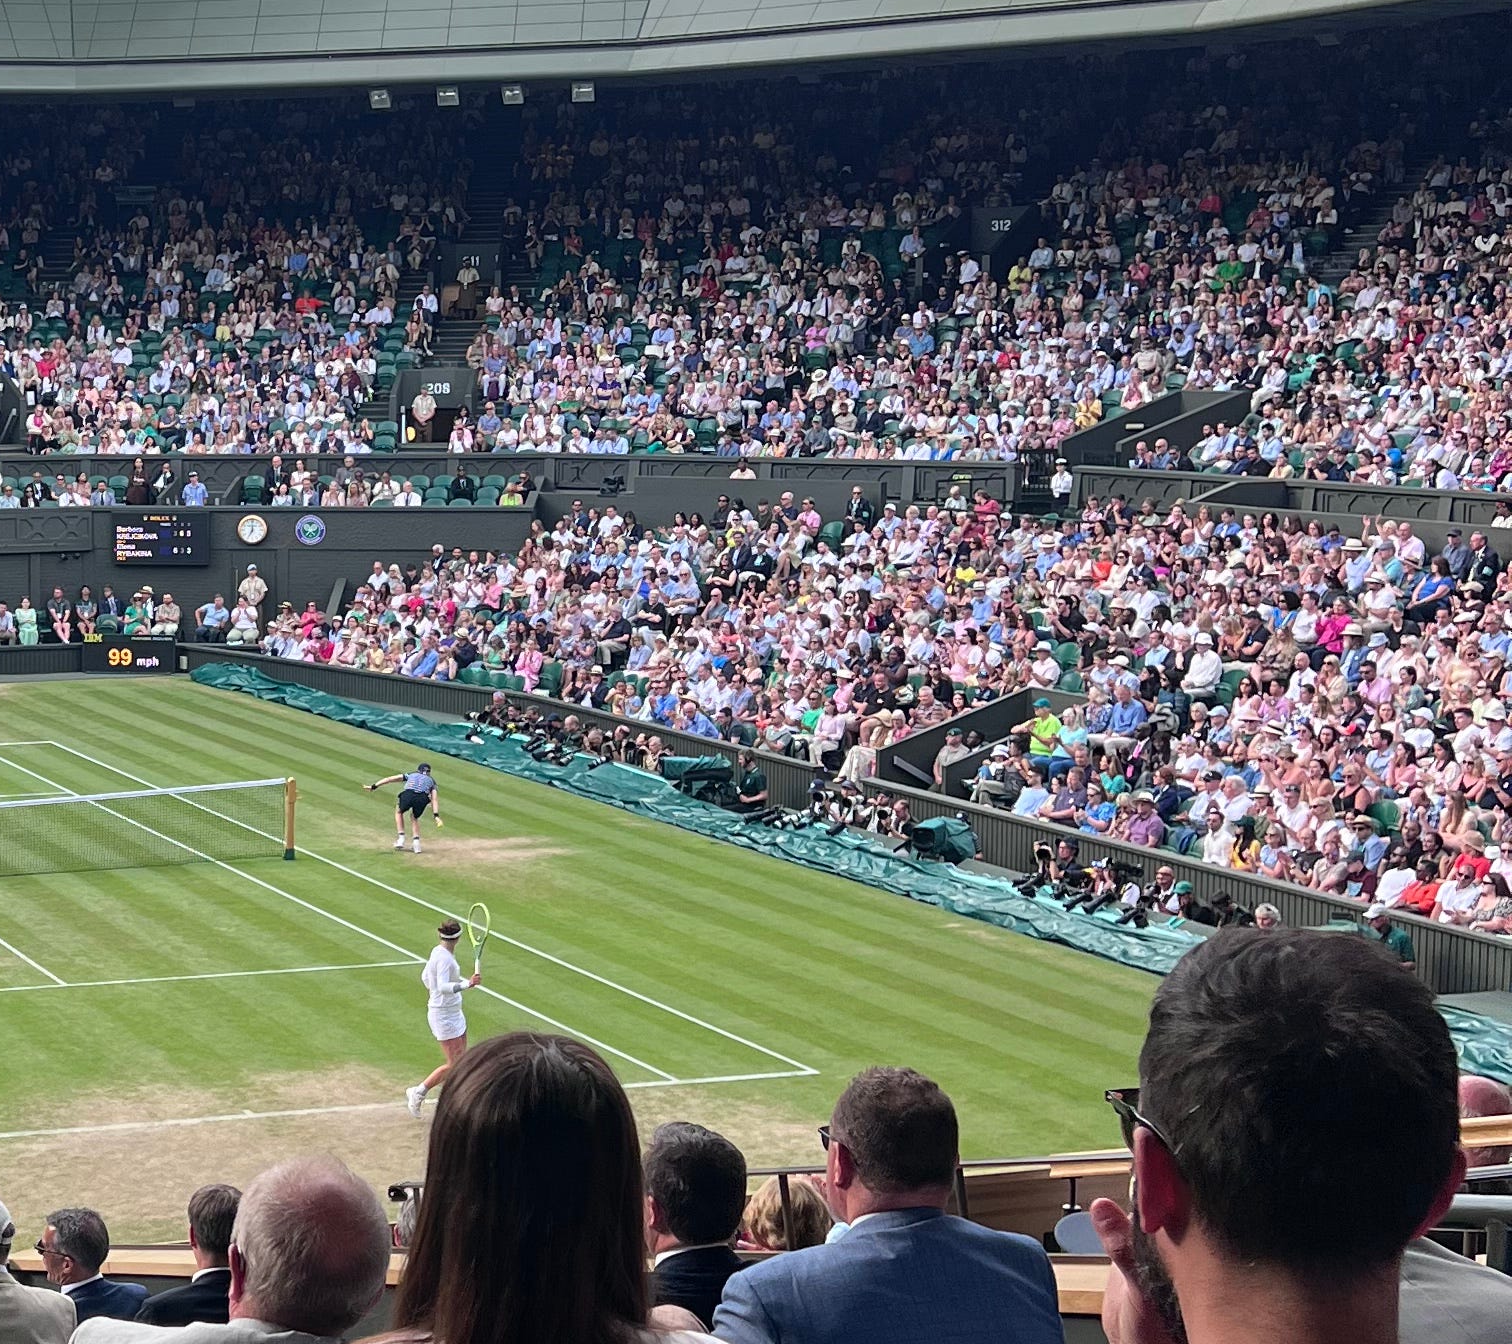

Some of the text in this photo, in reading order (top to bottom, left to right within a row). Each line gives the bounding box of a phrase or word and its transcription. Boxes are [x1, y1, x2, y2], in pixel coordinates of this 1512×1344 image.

[991, 219, 1012, 232] 312
[83, 633, 103, 643] IBM
[108, 648, 159, 668] 99 mph
